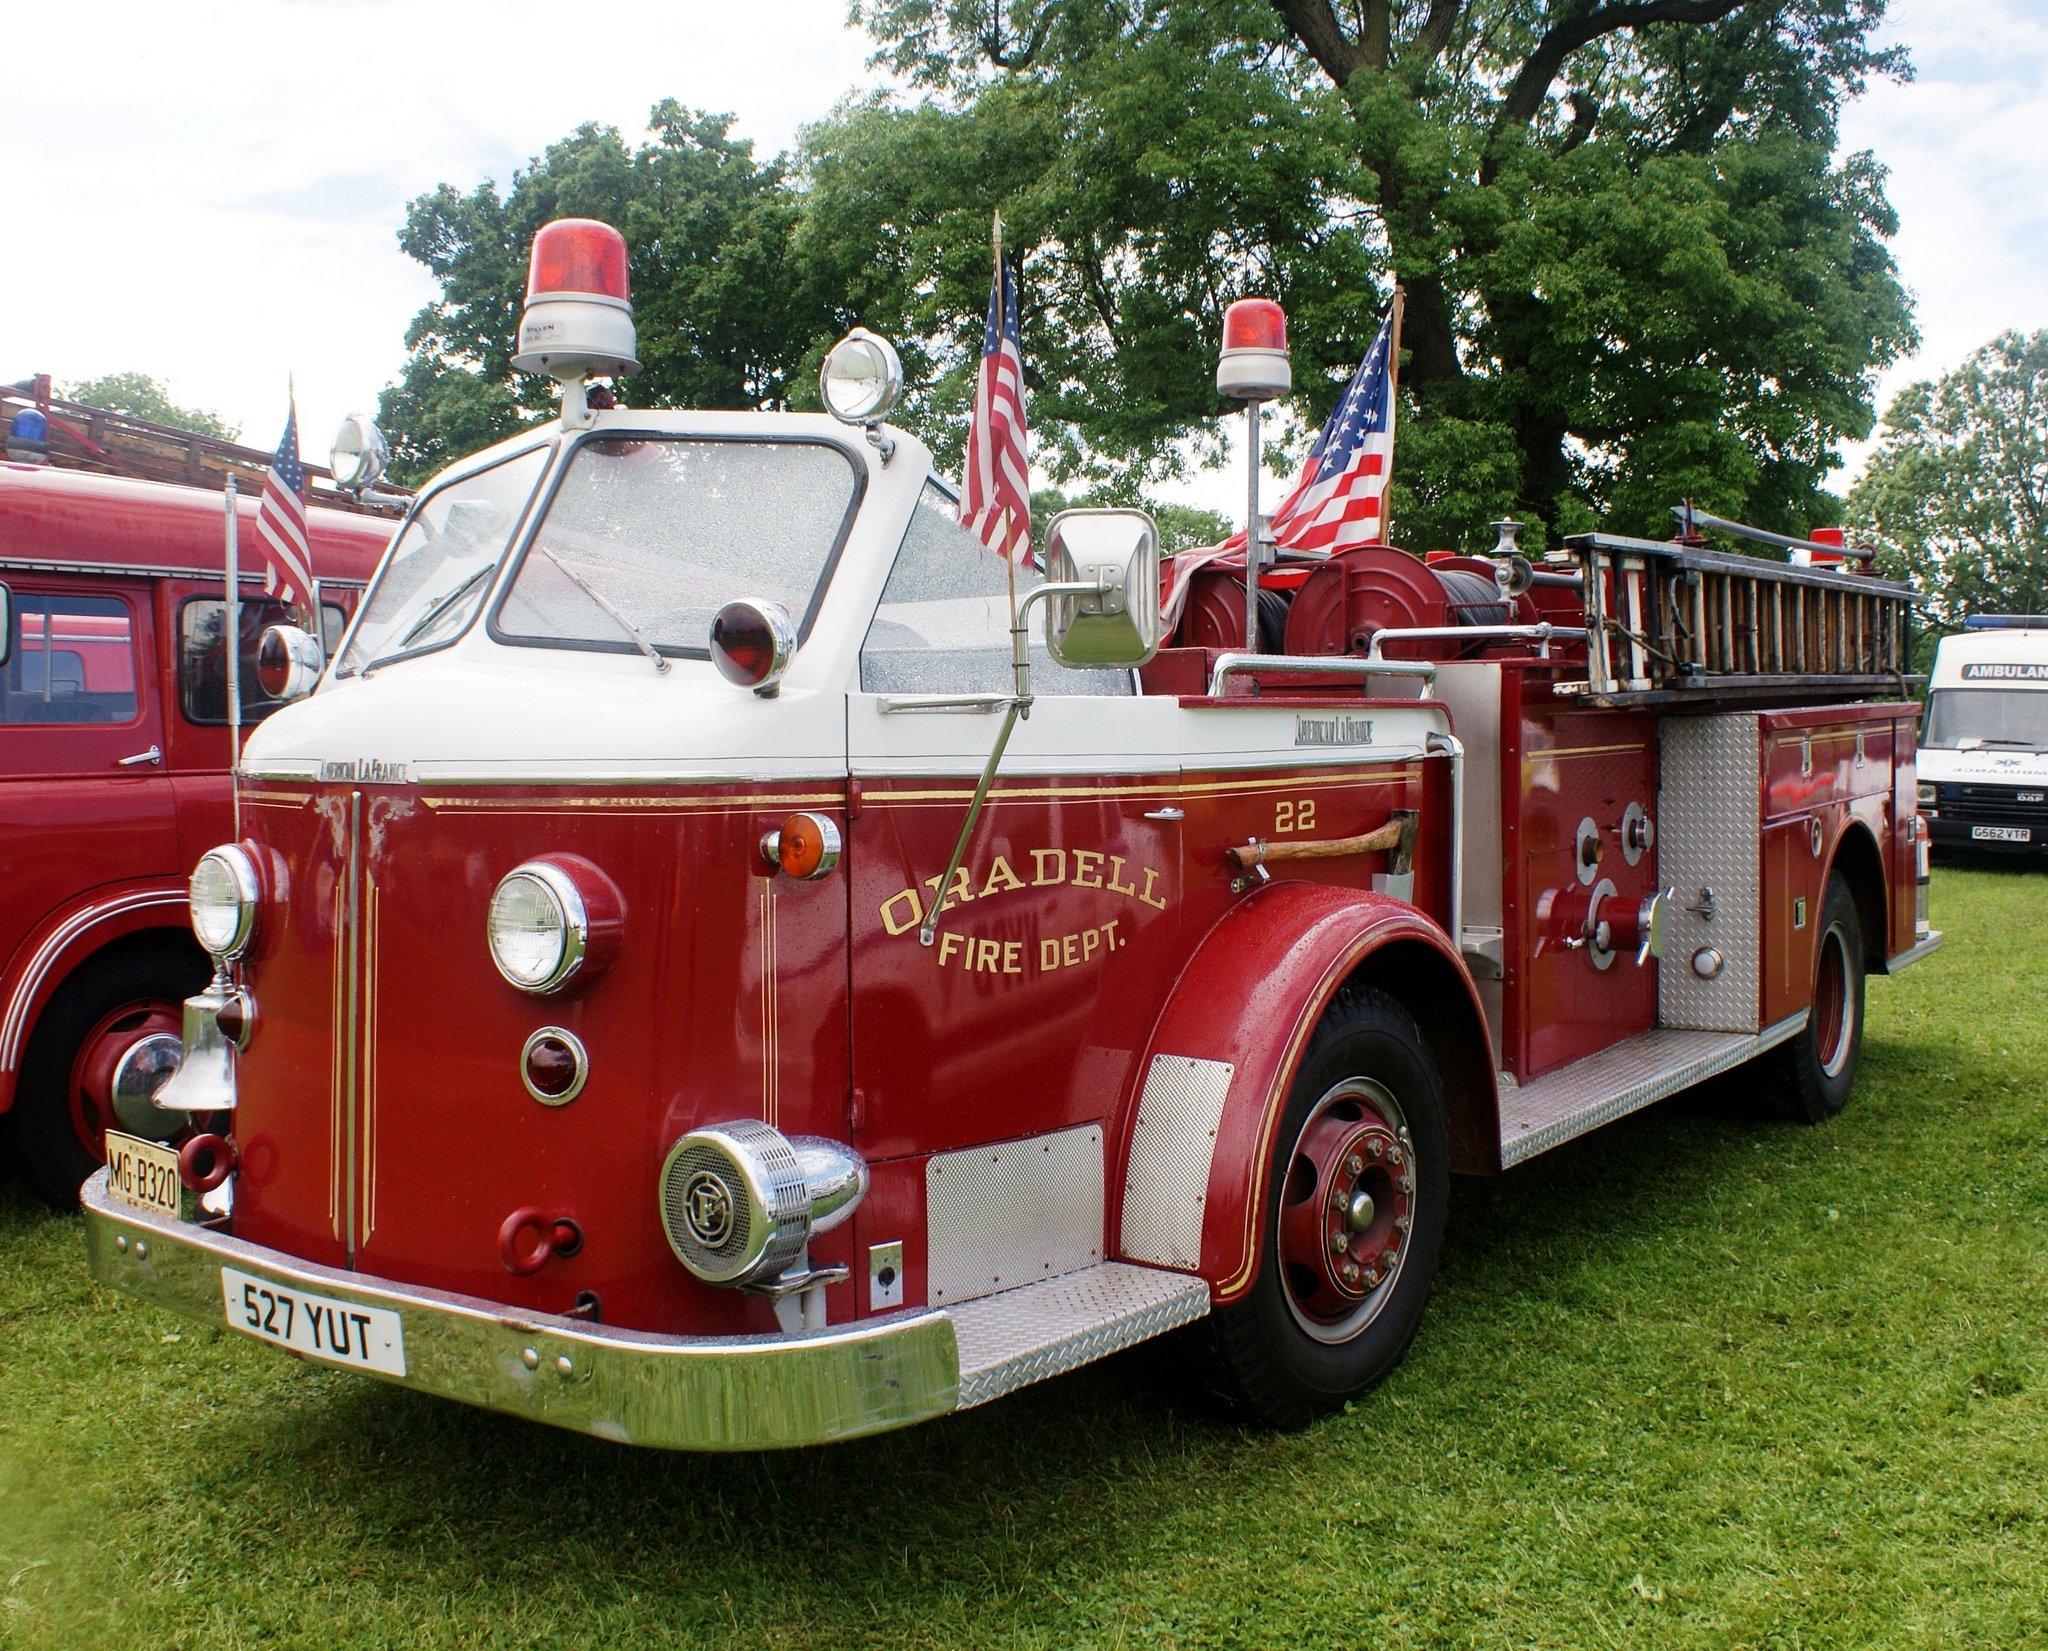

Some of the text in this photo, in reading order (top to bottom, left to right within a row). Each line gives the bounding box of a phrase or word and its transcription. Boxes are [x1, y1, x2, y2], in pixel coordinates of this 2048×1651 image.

[1275, 799, 1316, 833] 22
[1974, 827, 2028, 840] G562 VTR
[878, 848, 1167, 936] ORADELL
[938, 919, 1126, 974] FIRE DEPT.
[244, 1283, 371, 1360] 527 YUT
